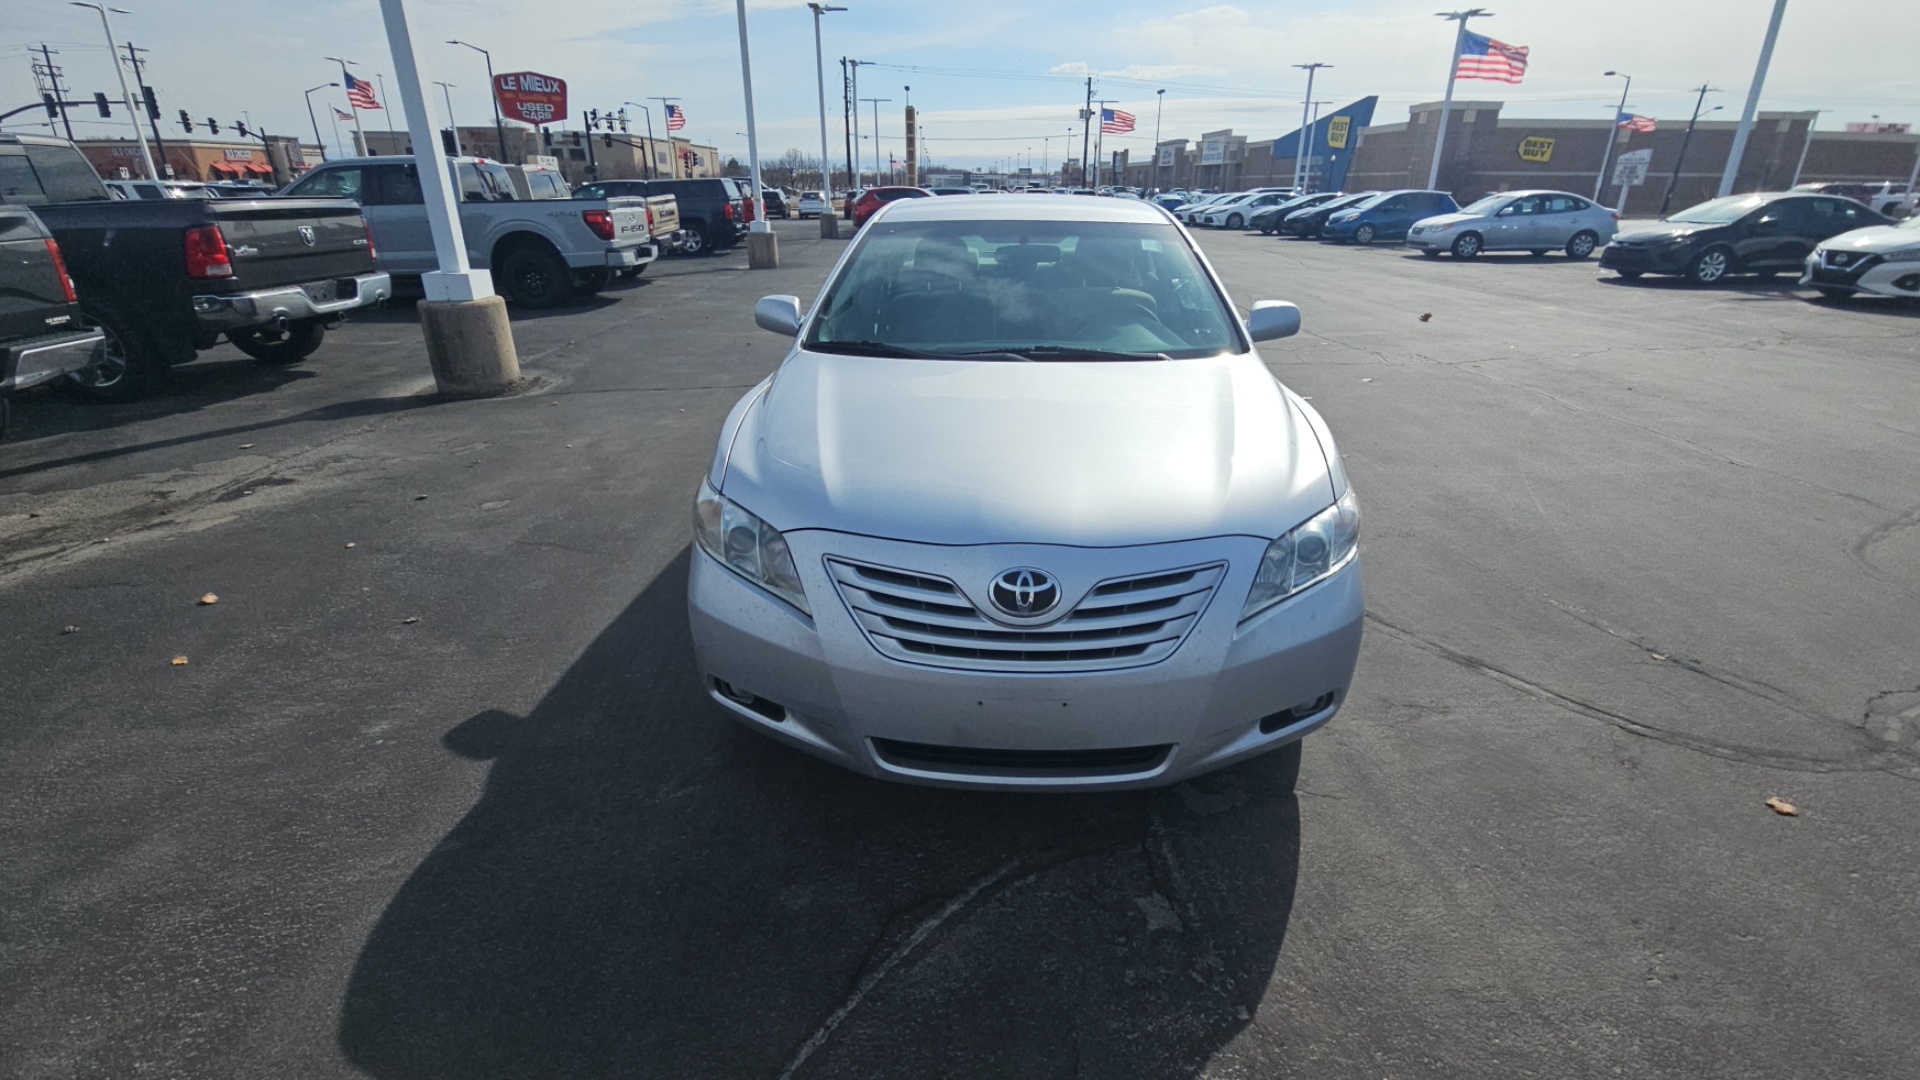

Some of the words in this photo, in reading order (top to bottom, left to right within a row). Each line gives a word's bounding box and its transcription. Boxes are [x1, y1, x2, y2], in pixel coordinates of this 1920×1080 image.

[500, 76, 517, 90] LE
[519, 75, 560, 93] MIEUX
[517, 102, 554, 112] USED
[522, 110, 552, 121] CARS
[1331, 121, 1349, 131] BEST
[1330, 132, 1346, 142] BUY
[1524, 140, 1553, 149] BEST
[1523, 148, 1549, 158] BUY
[621, 225, 644, 233] F-150
